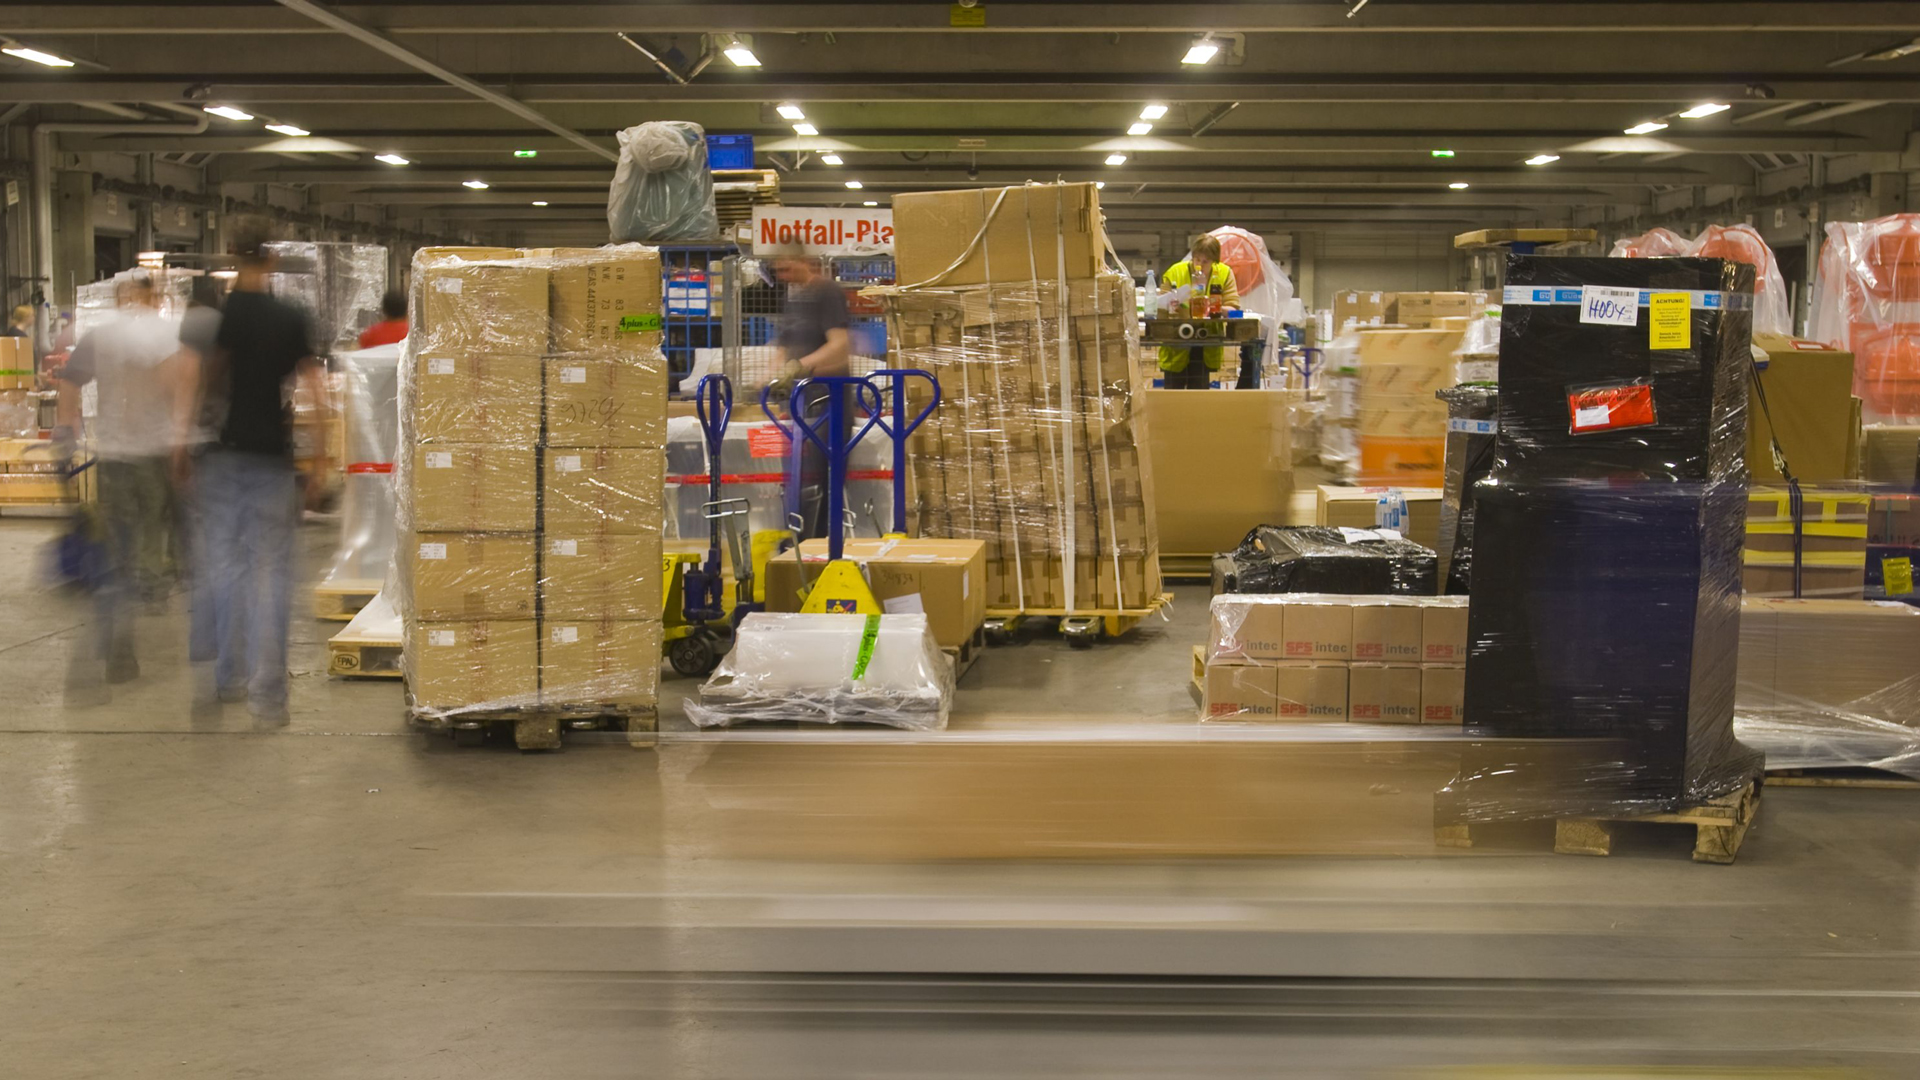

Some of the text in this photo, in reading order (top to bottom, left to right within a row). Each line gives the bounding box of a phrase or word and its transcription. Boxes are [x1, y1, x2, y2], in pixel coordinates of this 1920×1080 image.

[761, 218, 894, 245] Notfall-Pla
[1246, 640, 1278, 651] intec
[1286, 641, 1347, 654] SFS intec
[1356, 643, 1418, 655] SFS intec
[1426, 644, 1453, 656] SFS
[1211, 703, 1272, 715] SFS intec
[1280, 704, 1342, 716] SFS intec
[1353, 704, 1416, 716] SFS intec
[1425, 706, 1452, 717] SFS
